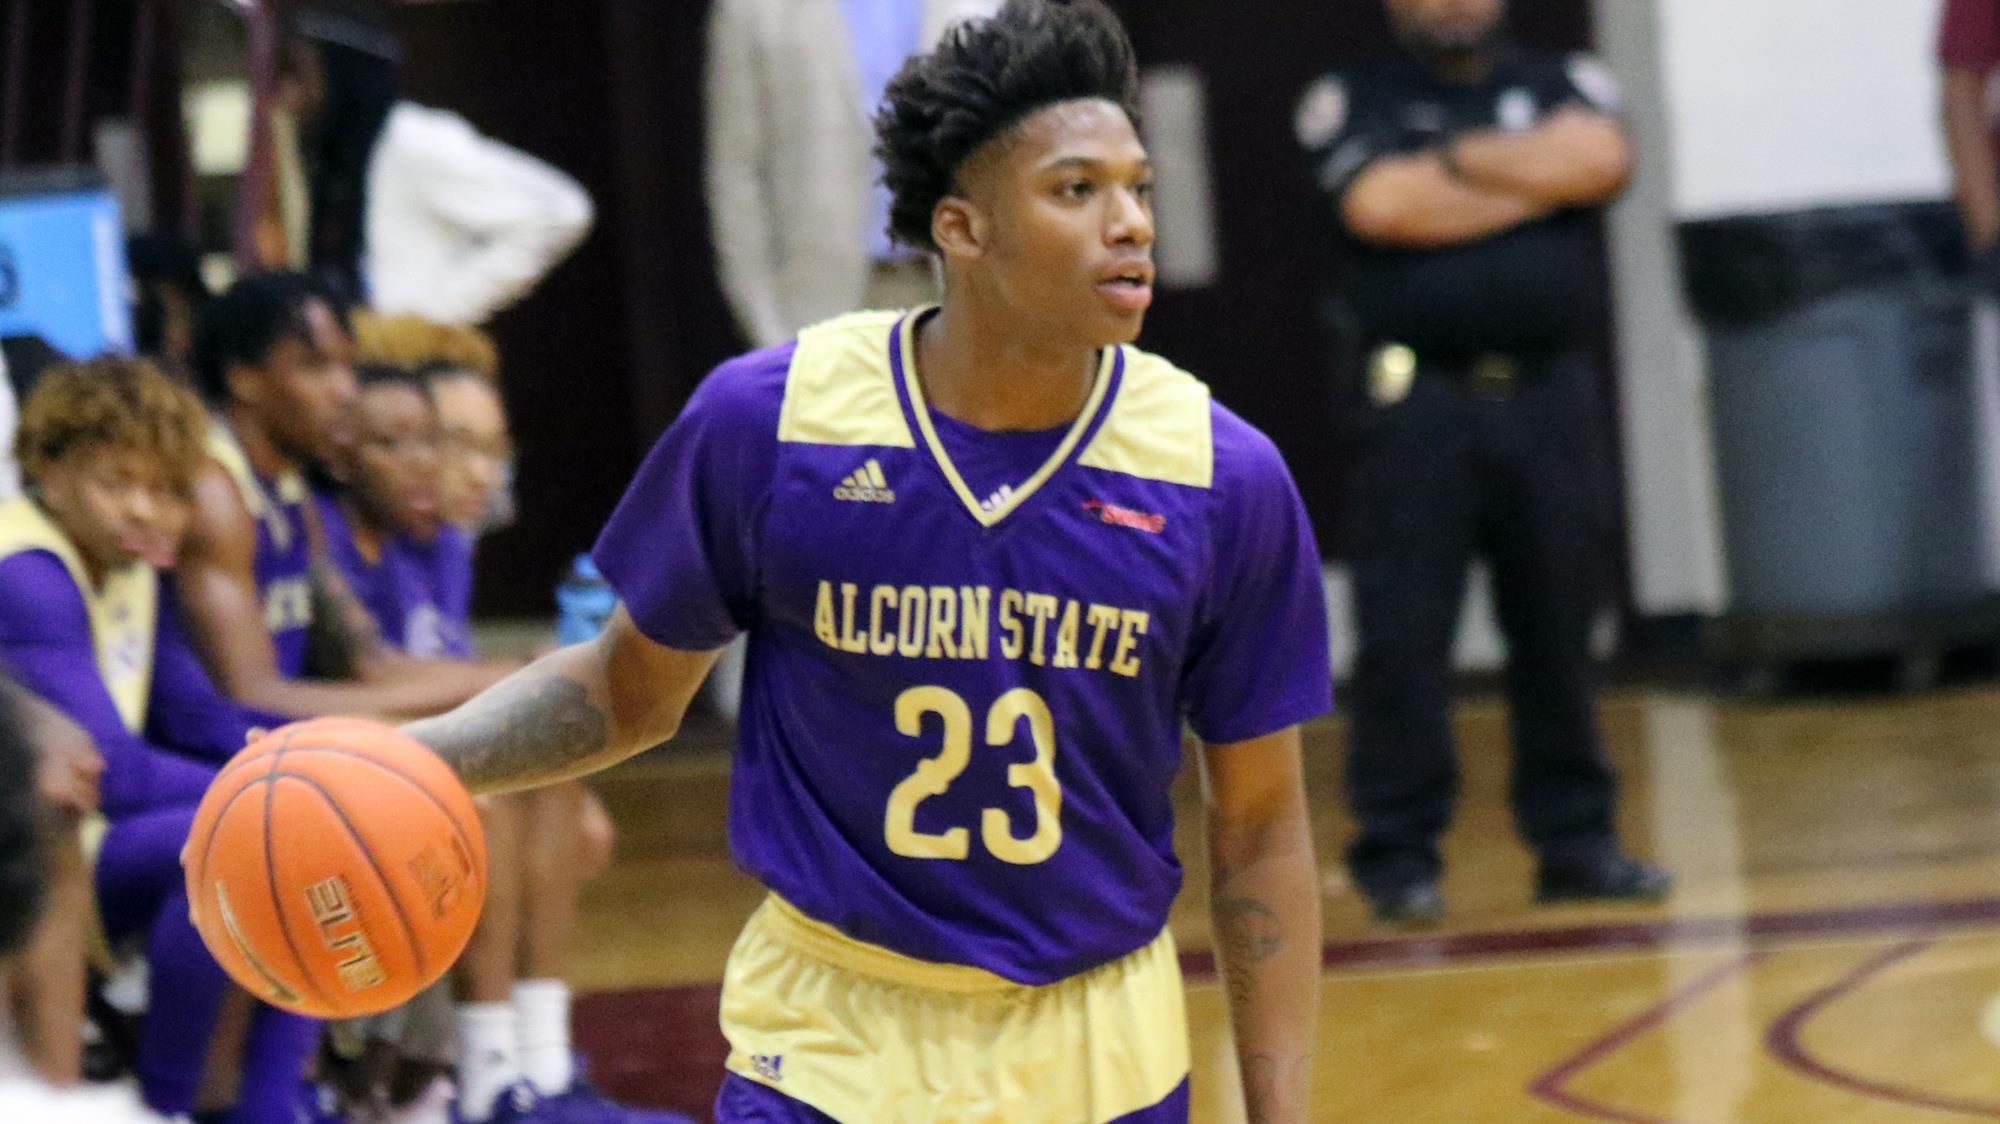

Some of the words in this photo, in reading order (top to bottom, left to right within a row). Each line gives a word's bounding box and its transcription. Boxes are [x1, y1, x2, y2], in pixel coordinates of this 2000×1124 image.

[833, 486, 896, 503] adidas
[813, 580, 991, 660] ALCORN
[998, 587, 1150, 678] STATE
[884, 685, 1063, 865] 23
